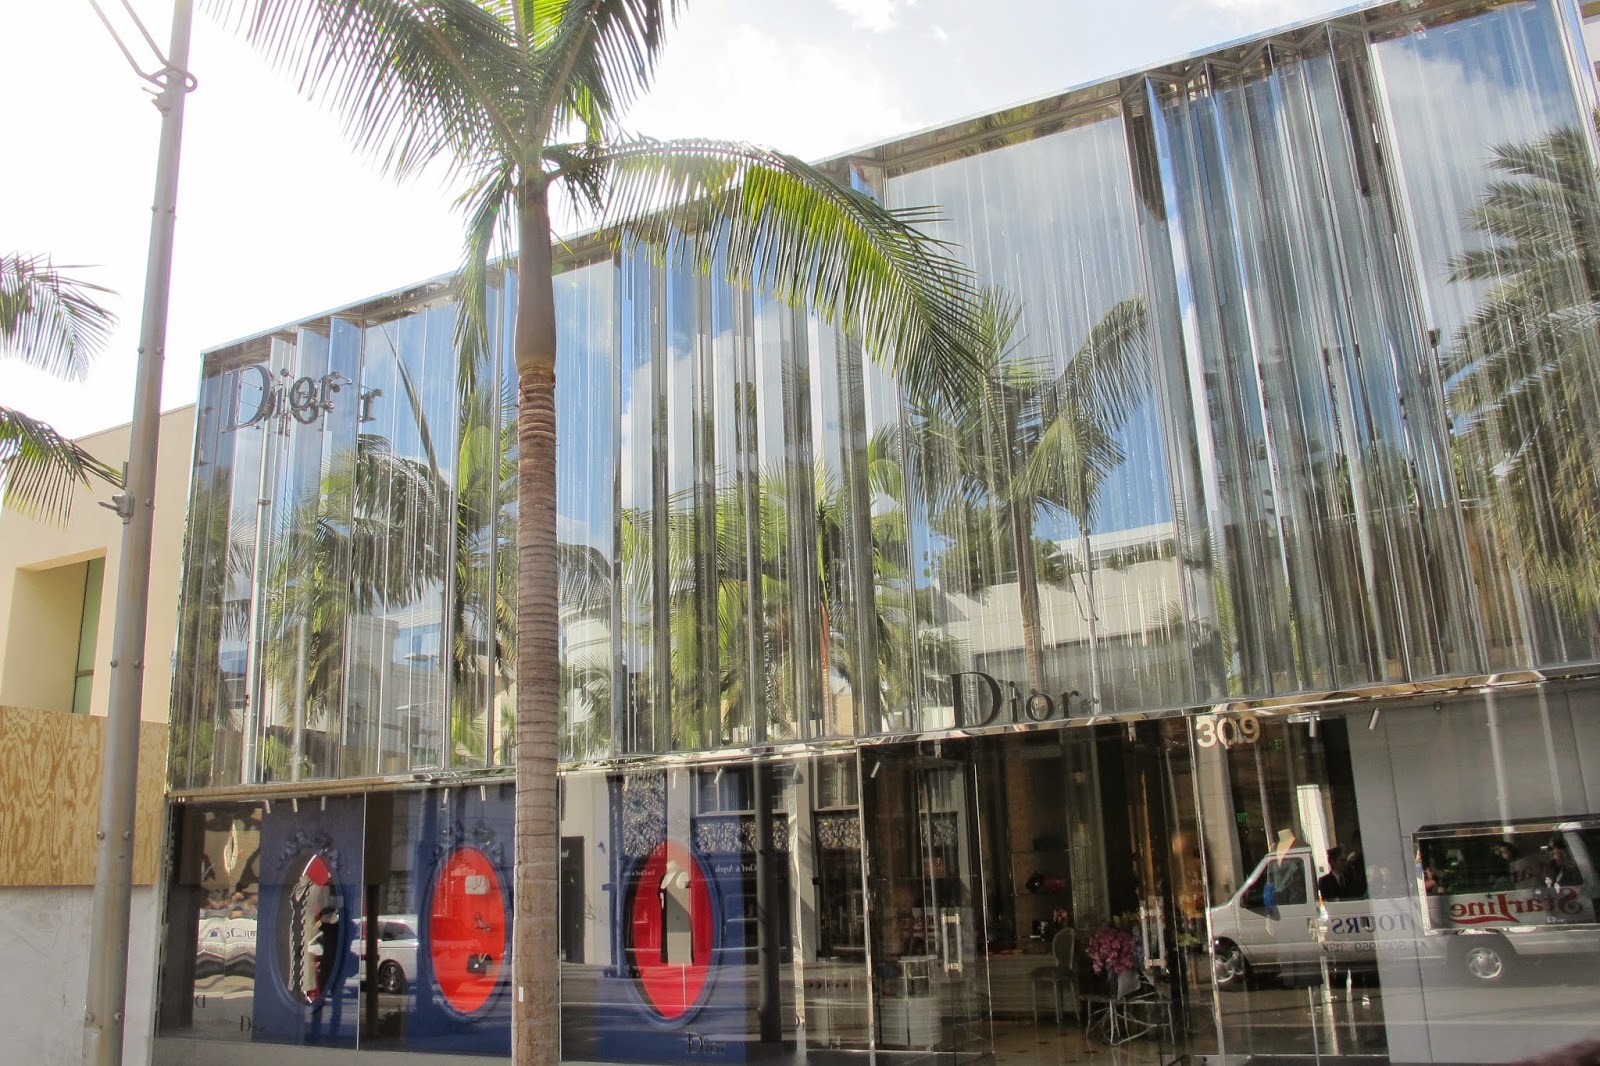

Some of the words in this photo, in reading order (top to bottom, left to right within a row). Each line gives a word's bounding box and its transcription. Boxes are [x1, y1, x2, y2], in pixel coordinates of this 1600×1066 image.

[219, 364, 341, 433] Dior
[948, 671, 1080, 728] Dior
[1195, 714, 1261, 748] 309
